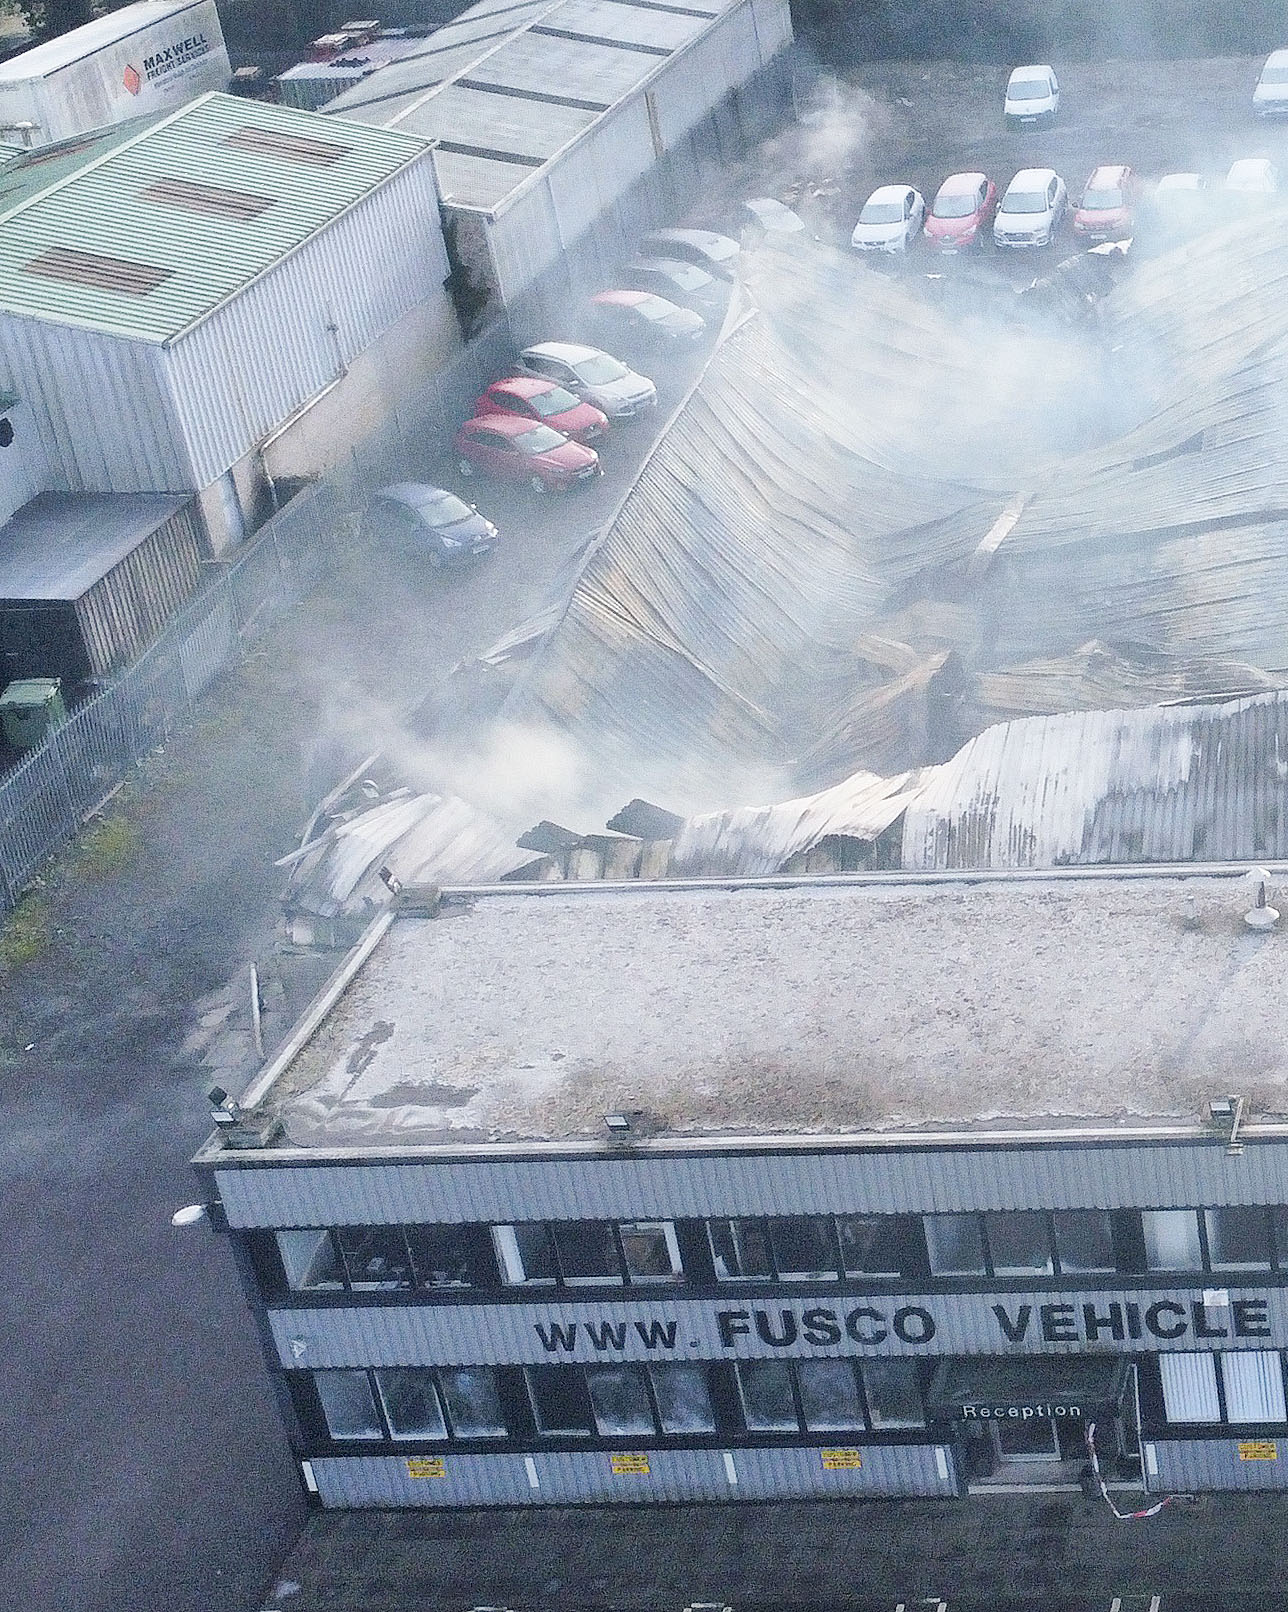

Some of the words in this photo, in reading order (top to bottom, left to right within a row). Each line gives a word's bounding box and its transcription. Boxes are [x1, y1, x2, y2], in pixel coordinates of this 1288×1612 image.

[143, 34, 207, 71] MAXWELL
[715, 1305, 937, 1347] FUSCO
[991, 1300, 1272, 1342] VEHICLE
[962, 1404, 1081, 1419] Reception
